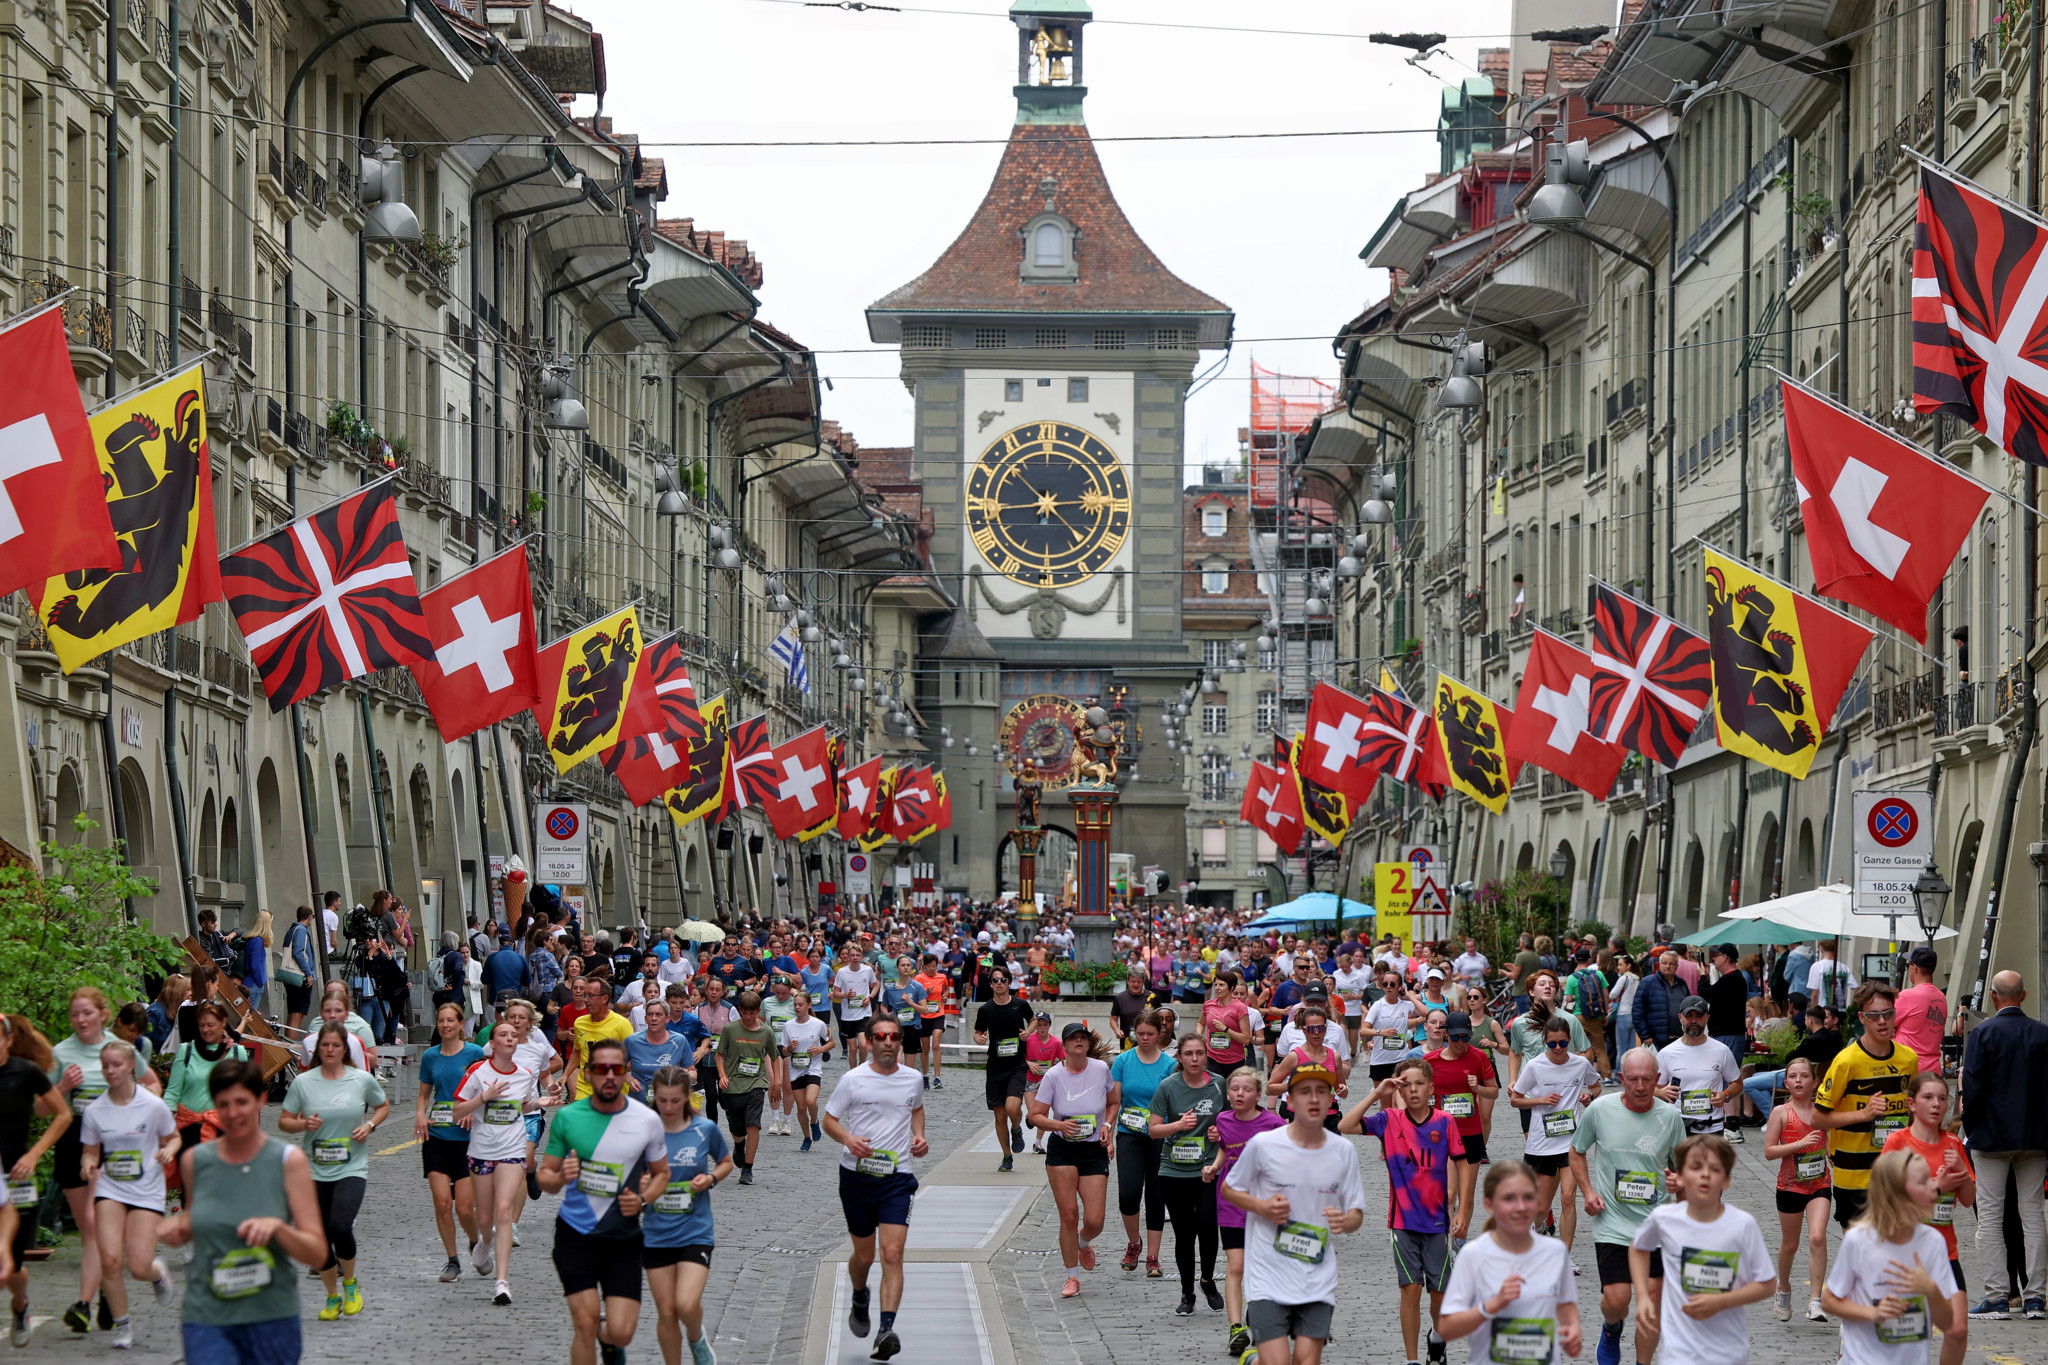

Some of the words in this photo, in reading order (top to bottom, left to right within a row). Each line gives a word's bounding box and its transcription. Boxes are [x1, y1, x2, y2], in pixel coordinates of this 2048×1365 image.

[542, 845, 561, 853] Ganze
[1863, 856, 1891, 866] Ganze
[1894, 857, 1922, 866] Gasse
[1390, 868, 1407, 894] 2
[1872, 882, 1914, 893] 18.05.24
[1388, 901, 1400, 909] Jitz
[1878, 895, 1906, 905] 12.00
[863, 1158, 892, 1168] Raphael
[1626, 1183, 1647, 1192] Peter
[1291, 1236, 1311, 1248] Fred
[1700, 1267, 1720, 1278] Nils
